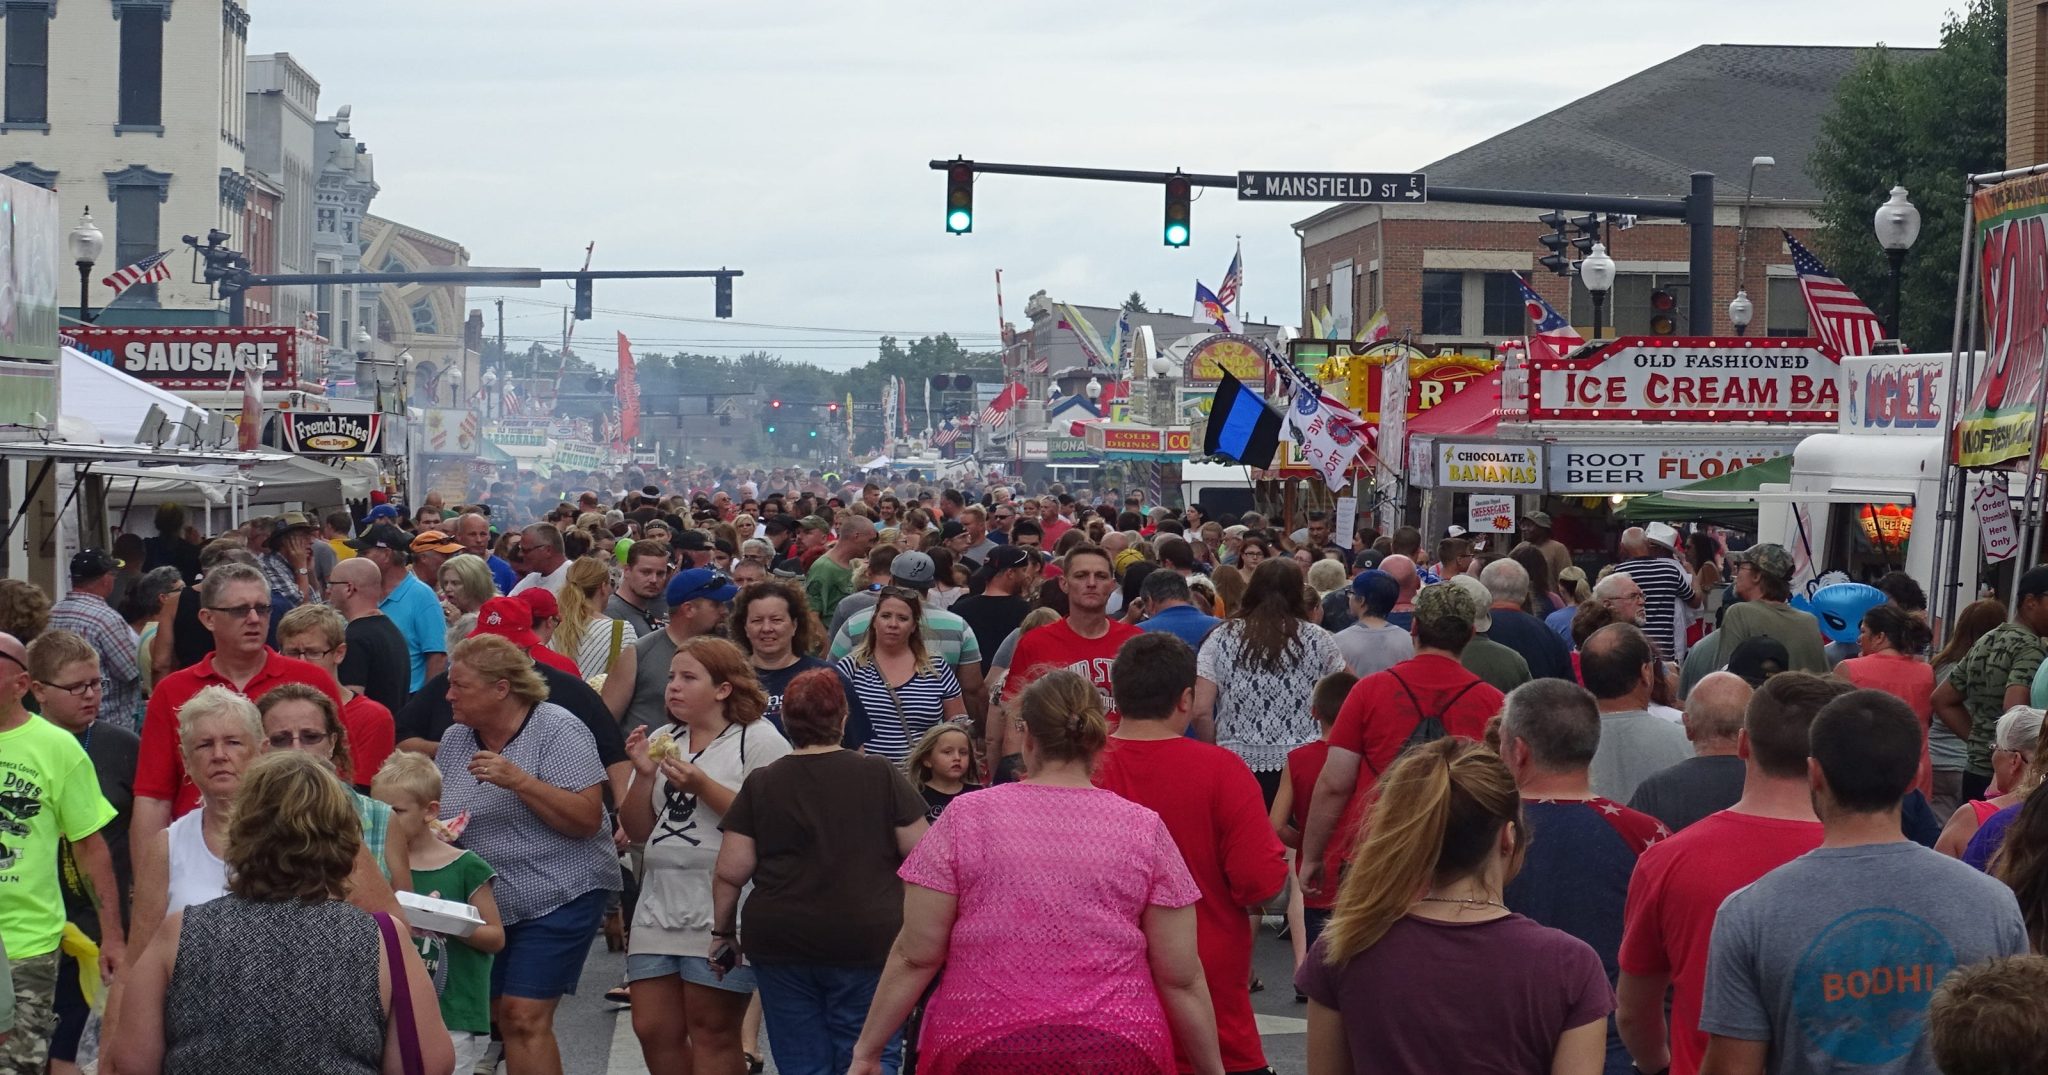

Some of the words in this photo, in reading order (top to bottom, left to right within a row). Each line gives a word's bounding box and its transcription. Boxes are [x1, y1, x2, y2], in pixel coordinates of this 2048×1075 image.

[1246, 175, 1254, 184] W
[1411, 177, 1417, 187] E
[1265, 176, 1372, 196] MANSFIELD
[1381, 183, 1398, 197] ST
[124, 342, 278, 371] SAUSAGE
[1633, 354, 1676, 368] OLD
[1685, 355, 1809, 369] FASHIONED
[1199, 366, 1259, 378] WAON
[1566, 373, 1627, 403] ICE
[1646, 373, 1778, 405] CREAM
[1790, 375, 1839, 404] BA
[1865, 363, 1943, 428] ICEE
[296, 416, 336, 440] French
[338, 417, 368, 442] Fries
[333, 439, 349, 448] Dogs
[1458, 452, 1525, 463] CHOCOLATE
[1567, 454, 1645, 467] ROOT
[1449, 465, 1536, 483] BANANAS
[1567, 471, 1644, 483] BEER
[1472, 504, 1511, 518] CHEESECAKE
[1982, 500, 2005, 511] Order
[1982, 511, 2009, 524] Stromboli
[1989, 526, 2007, 535] Here
[1991, 537, 2010, 547] Only
[0, 761, 17, 769] eneca
[18, 763, 39, 779] County
[4, 772, 42, 798] Dogs
[1823, 963, 1934, 1003] BODHI
